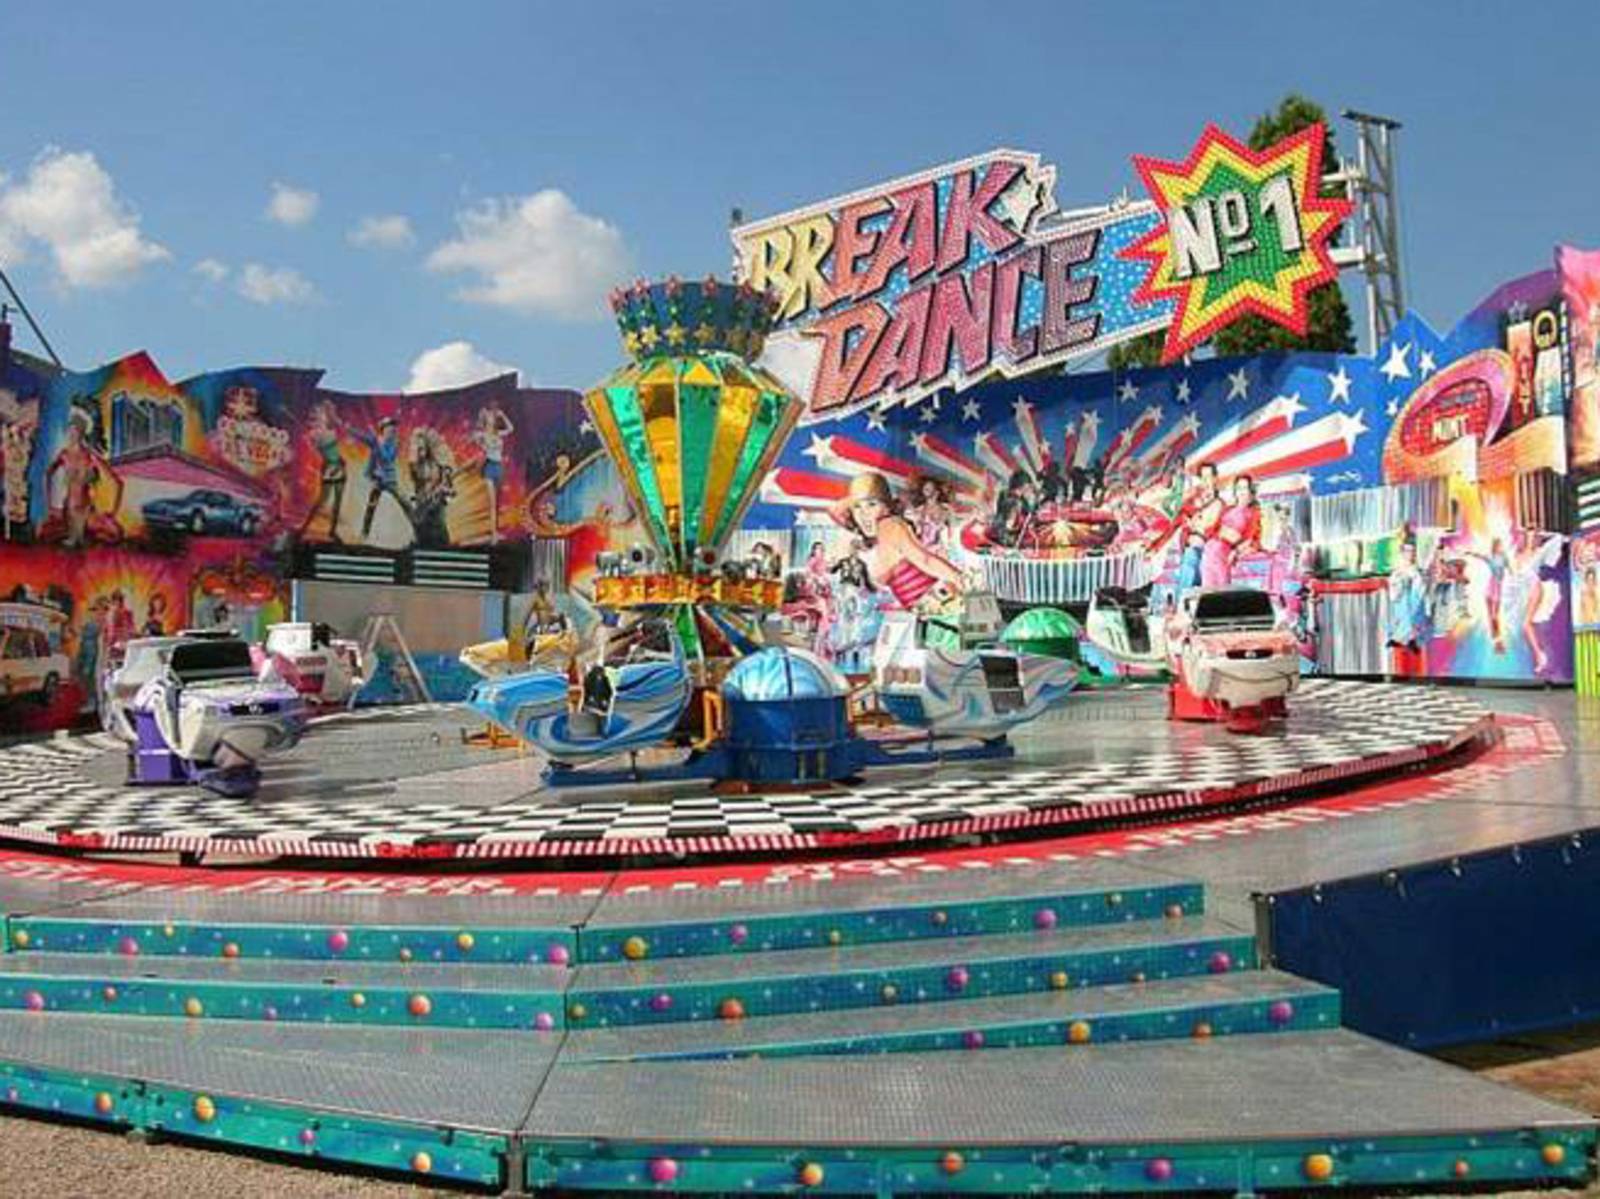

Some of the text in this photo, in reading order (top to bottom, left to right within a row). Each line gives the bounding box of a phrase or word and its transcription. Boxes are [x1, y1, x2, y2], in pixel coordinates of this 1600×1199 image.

[744, 159, 1024, 324] BREAK
[1259, 176, 1304, 253] 1
[801, 229, 1103, 412] DANCE
